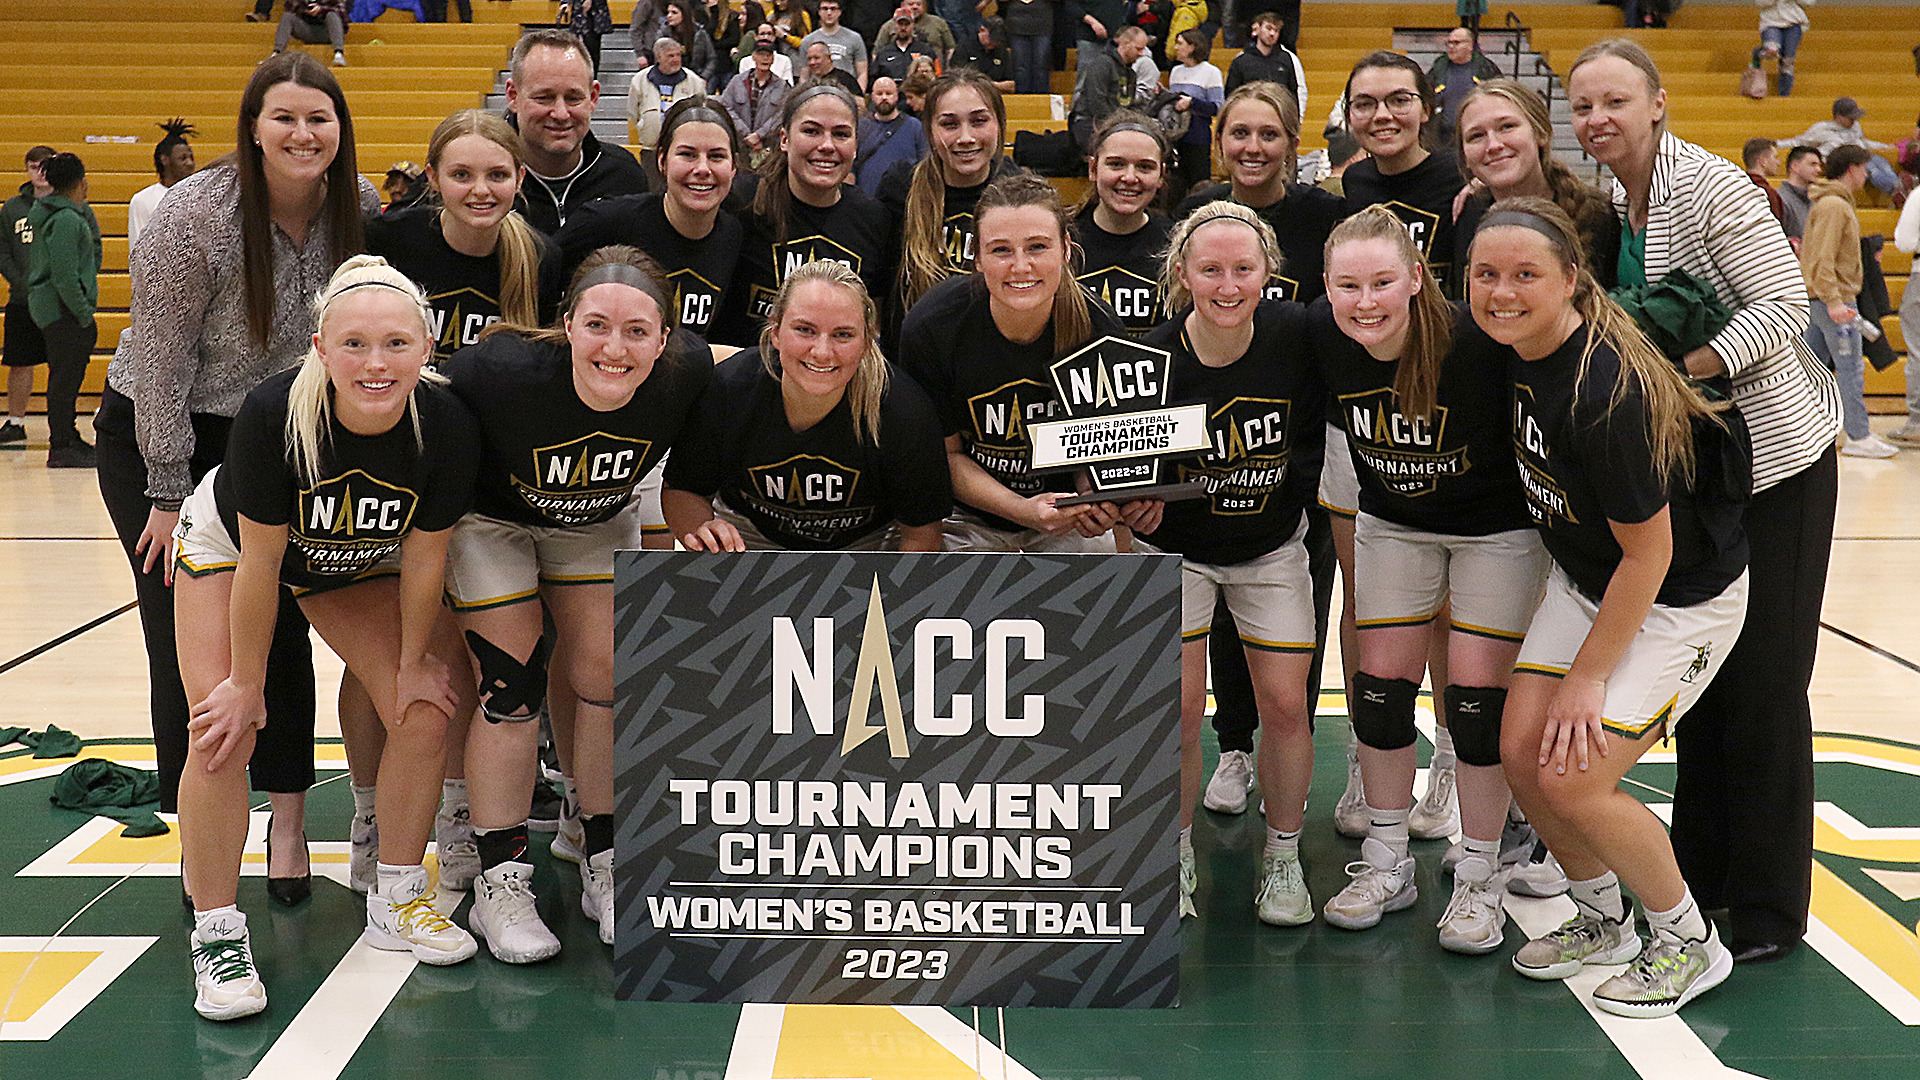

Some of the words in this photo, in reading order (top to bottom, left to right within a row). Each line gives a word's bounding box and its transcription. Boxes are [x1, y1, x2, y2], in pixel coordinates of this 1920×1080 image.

[1069, 352, 1158, 409] NACC
[1059, 421, 1179, 447] TOURNAMENT
[1064, 421, 1110, 433] WOMEN'S
[1113, 414, 1173, 428] BASKETBALL
[1353, 401, 1432, 447] NACC
[546, 446, 634, 488] NACC
[1066, 435, 1170, 459] CHAMPIONS
[765, 467, 844, 507] NACC
[1101, 464, 1150, 480] 2022-23
[310, 483, 400, 536] NACC
[1222, 499, 1255, 509] 2023
[772, 570, 1046, 759] NACC
[669, 779, 1122, 830] TOURNAMENT
[718, 832, 1073, 879] CHAMPIONS
[647, 895, 853, 932] WOMEN'S
[863, 898, 1146, 936] BASKETBALL
[841, 948, 950, 981] 2023
